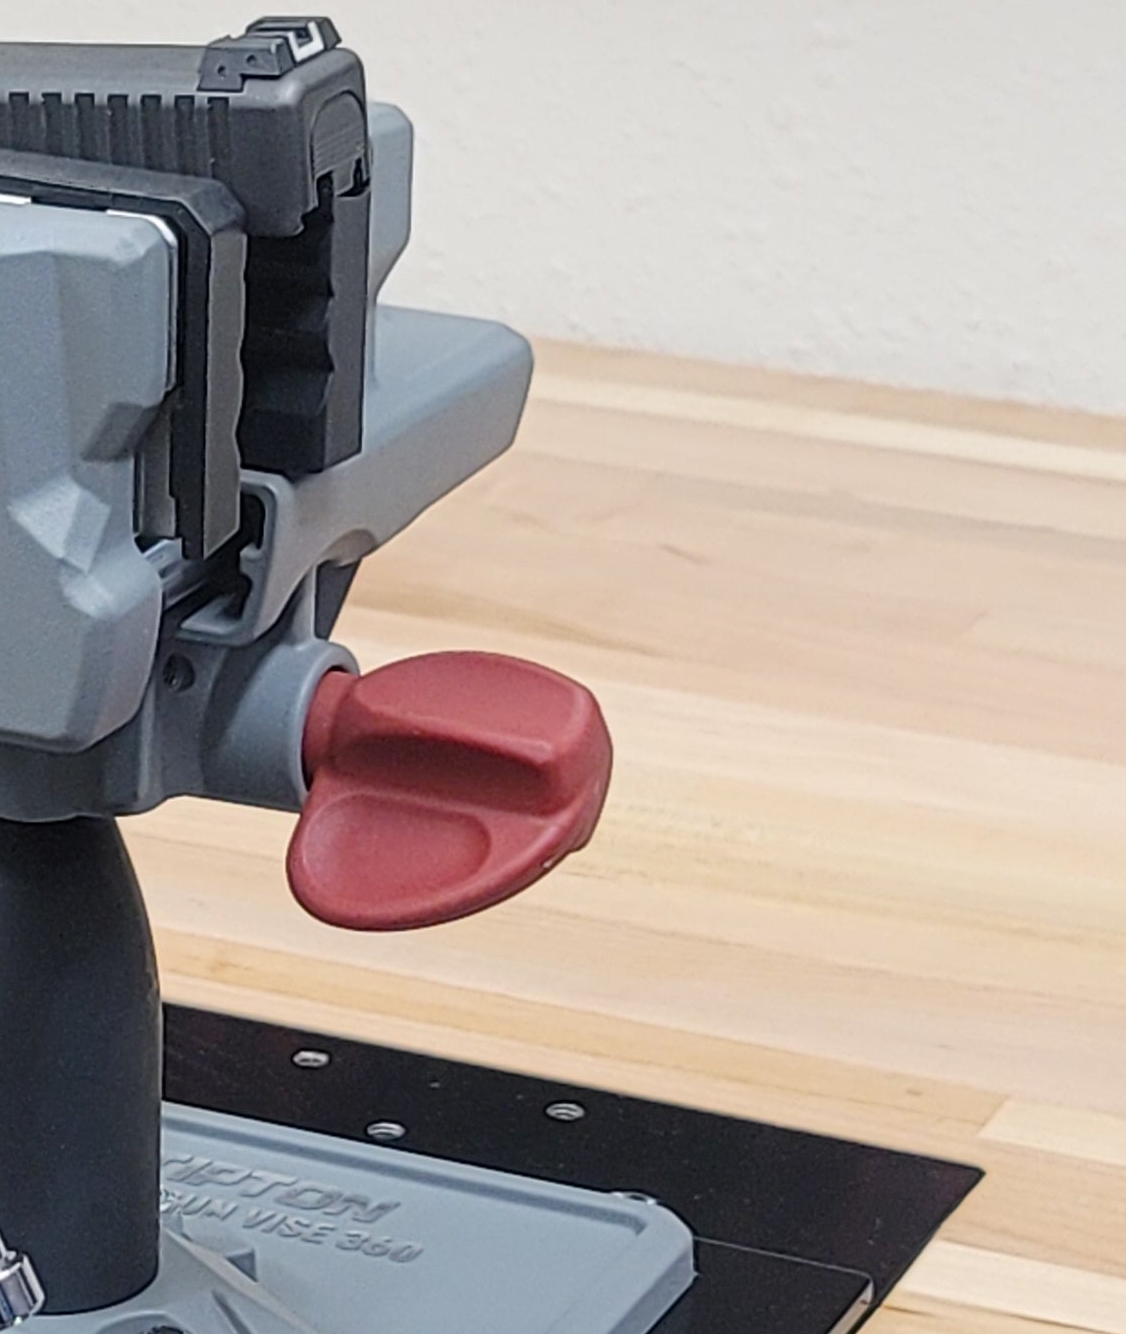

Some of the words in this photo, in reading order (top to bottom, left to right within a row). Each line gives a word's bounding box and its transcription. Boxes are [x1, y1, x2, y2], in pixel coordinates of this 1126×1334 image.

[162, 1154, 402, 1224] TIPTON
[242, 1208, 337, 1245] VISE
[335, 1230, 425, 1264] 360
